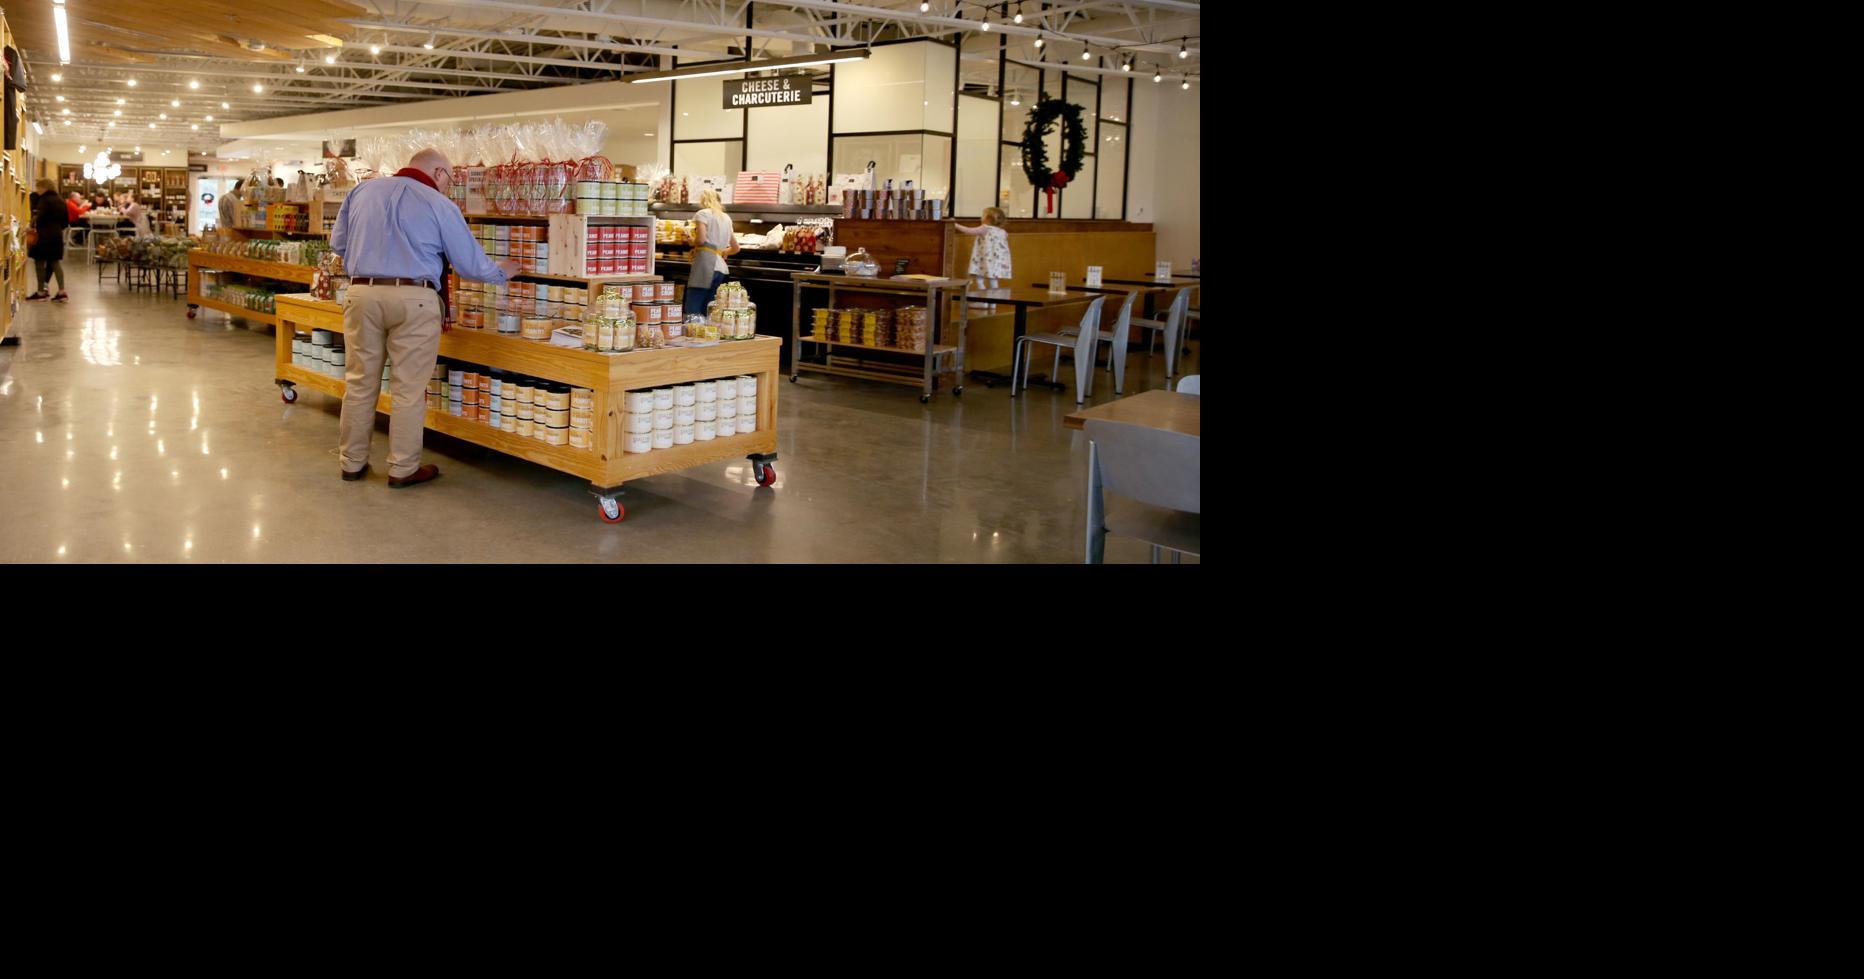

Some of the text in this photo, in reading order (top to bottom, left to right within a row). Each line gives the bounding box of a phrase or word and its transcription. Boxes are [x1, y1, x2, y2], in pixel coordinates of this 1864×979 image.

[742, 78, 790, 93] CHEESE &
[732, 90, 800, 106] CHARCUTERIE
